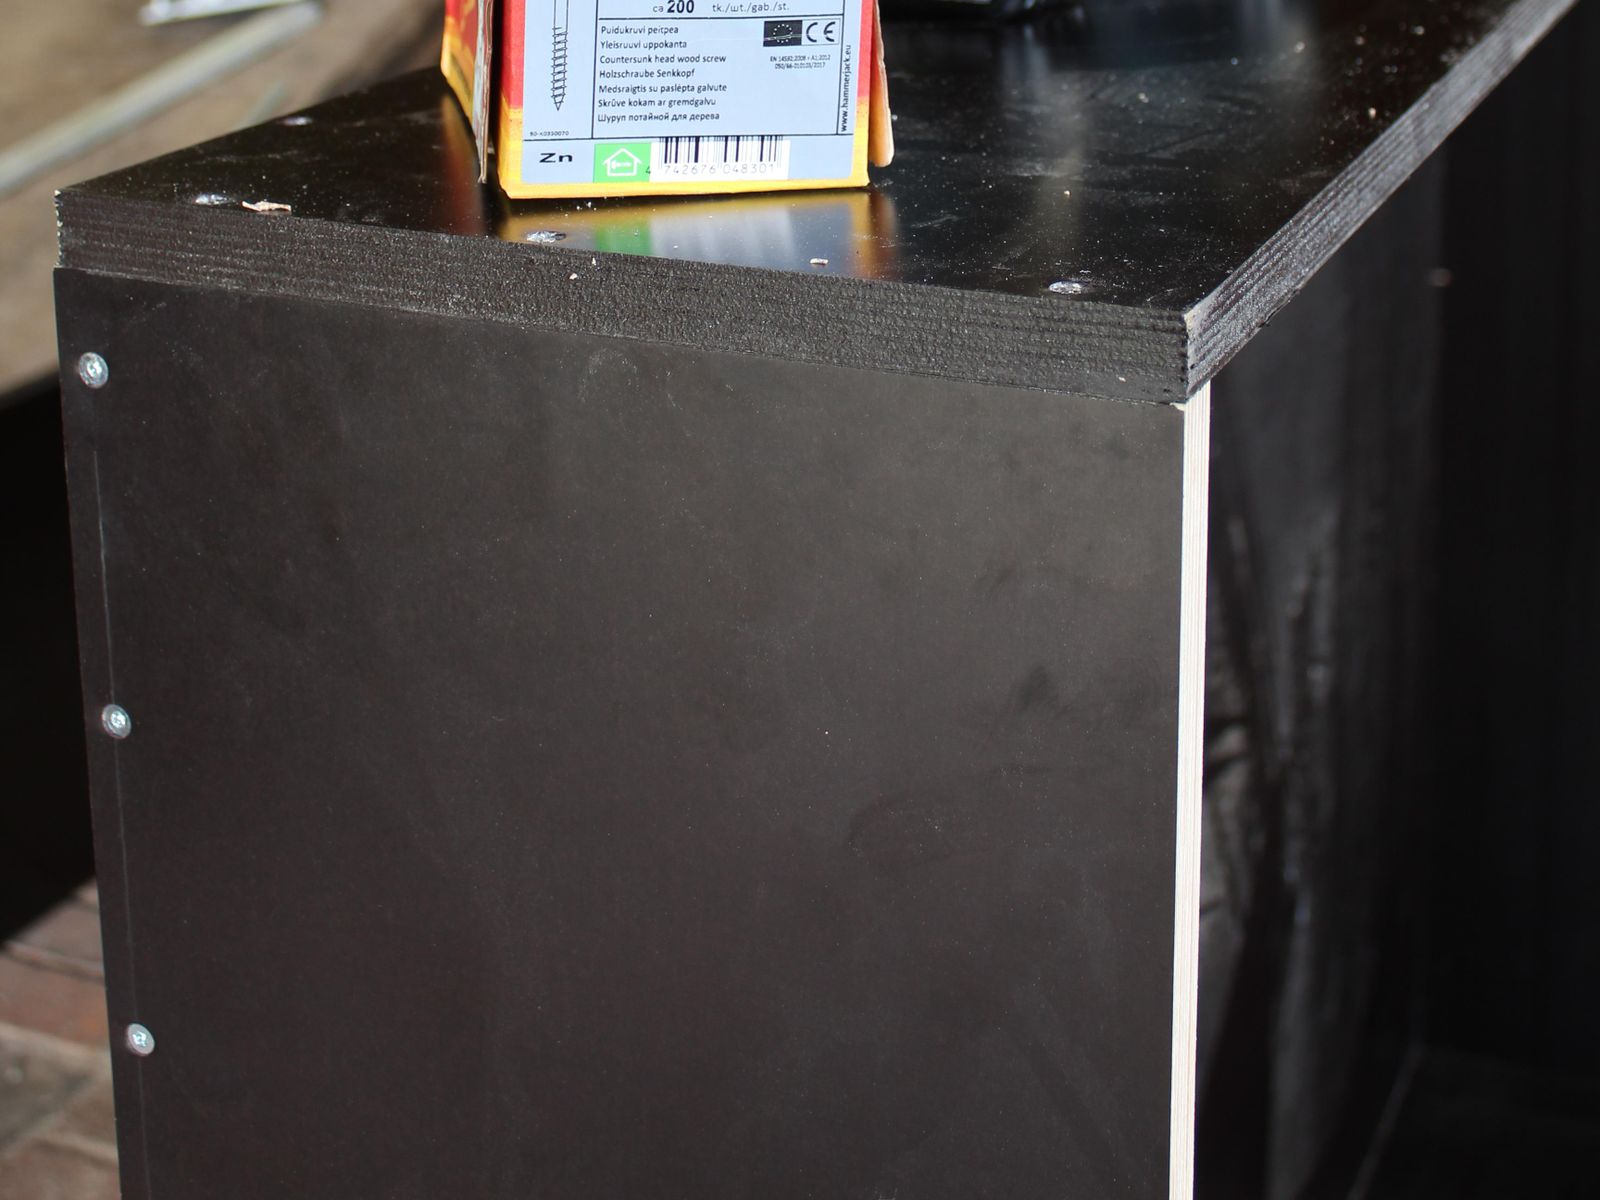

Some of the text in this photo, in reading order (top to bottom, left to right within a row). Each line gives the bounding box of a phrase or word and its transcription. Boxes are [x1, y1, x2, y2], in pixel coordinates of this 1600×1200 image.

[652, 4, 664, 13] ca
[667, 0, 695, 14] 200
[600, 26, 679, 36] Puidukruvi peitpea
[600, 39, 688, 51] Yleisruuvi uppokanta
[599, 54, 727, 64] Countersunk head wood screw
[599, 68, 696, 79] Holzschraube Senkkopf
[598, 84, 647, 95] Medsraigtis
[697, 82, 728, 94] galvute
[840, 44, 852, 132] www.hammerjack.eu
[627, 98, 656, 108] kokam
[668, 97, 717, 108] gremdgalvu
[597, 111, 721, 123] Шуруп потайной для дерева
[539, 152, 574, 164] Zn
